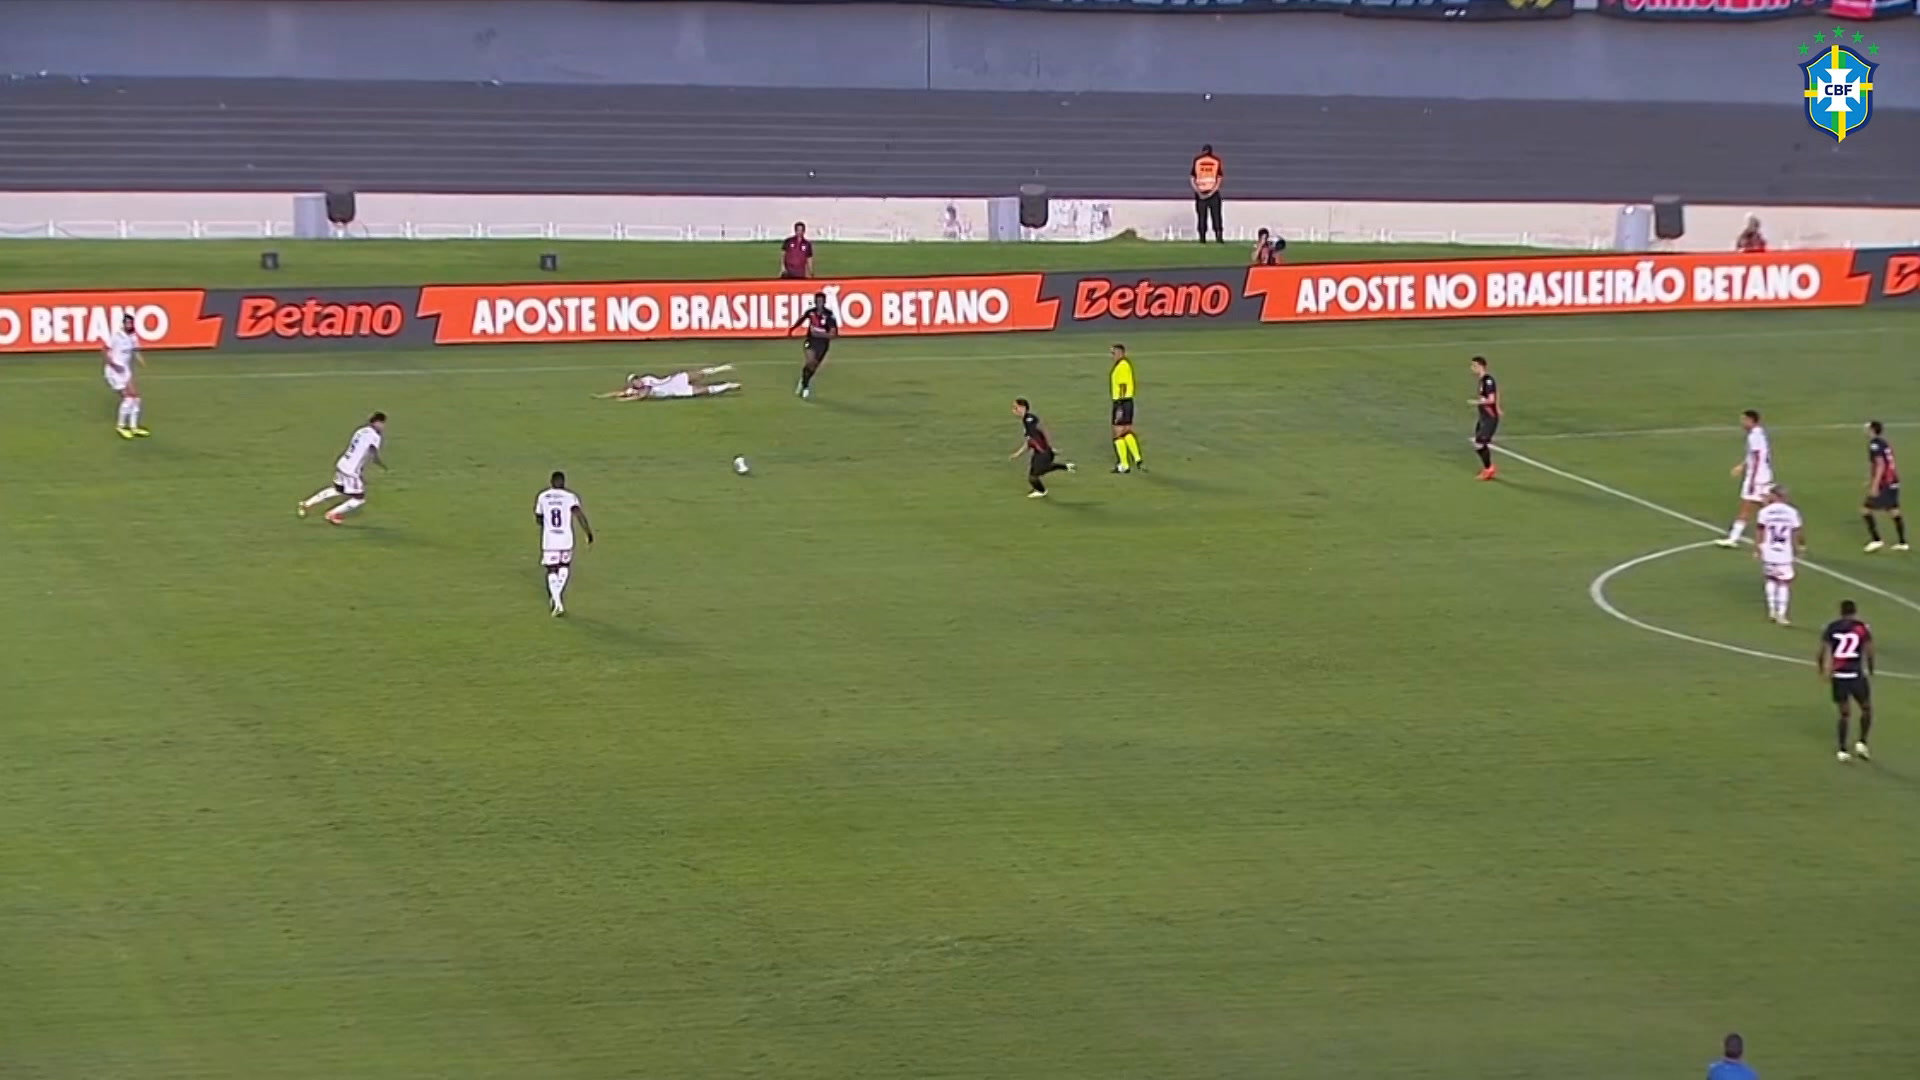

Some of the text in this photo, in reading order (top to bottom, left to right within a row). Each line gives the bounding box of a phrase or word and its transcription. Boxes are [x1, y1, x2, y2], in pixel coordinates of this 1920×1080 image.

[1073, 278, 1231, 320] Betano
[1295, 259, 1821, 314] APOSTE NO BRASILEIRÃO BETANO
[30, 304, 169, 344] BETANO
[236, 297, 403, 338] Betano
[471, 297, 597, 335] APOSTE
[606, 295, 661, 333] NO
[881, 287, 1010, 327] BETANO
[551, 507, 562, 528] 8
[1832, 632, 1860, 658] 22
